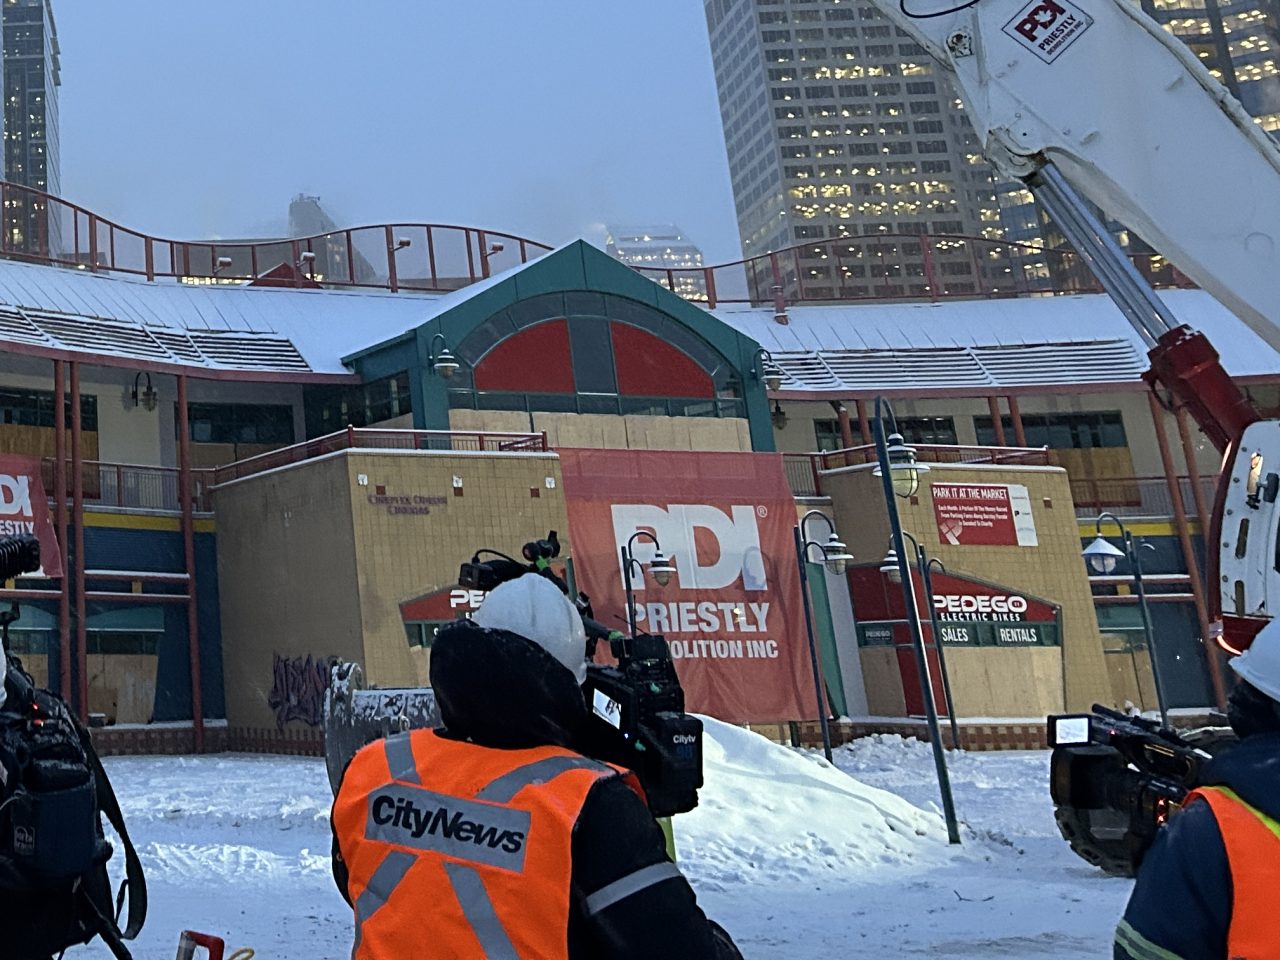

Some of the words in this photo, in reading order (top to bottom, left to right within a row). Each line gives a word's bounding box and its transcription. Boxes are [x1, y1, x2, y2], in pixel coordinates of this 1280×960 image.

[1038, 14, 1077, 51] PRIESTLY
[932, 487, 951, 498] PARK
[951, 488, 958, 498] IT
[959, 488, 967, 498] AT
[967, 488, 980, 499] THE
[980, 489, 1007, 500] MARKET
[611, 504, 768, 591] PDI
[932, 595, 1028, 613] PEDEGO
[625, 602, 770, 633] PRIESTLY
[940, 612, 988, 622] ELECTRIC
[992, 613, 1021, 622] BIKES
[941, 628, 969, 642] SALES
[1000, 628, 1037, 642] RENTALS
[668, 640, 744, 659] OLITION
[747, 640, 779, 659] INC
[372, 795, 525, 854] CityNews
